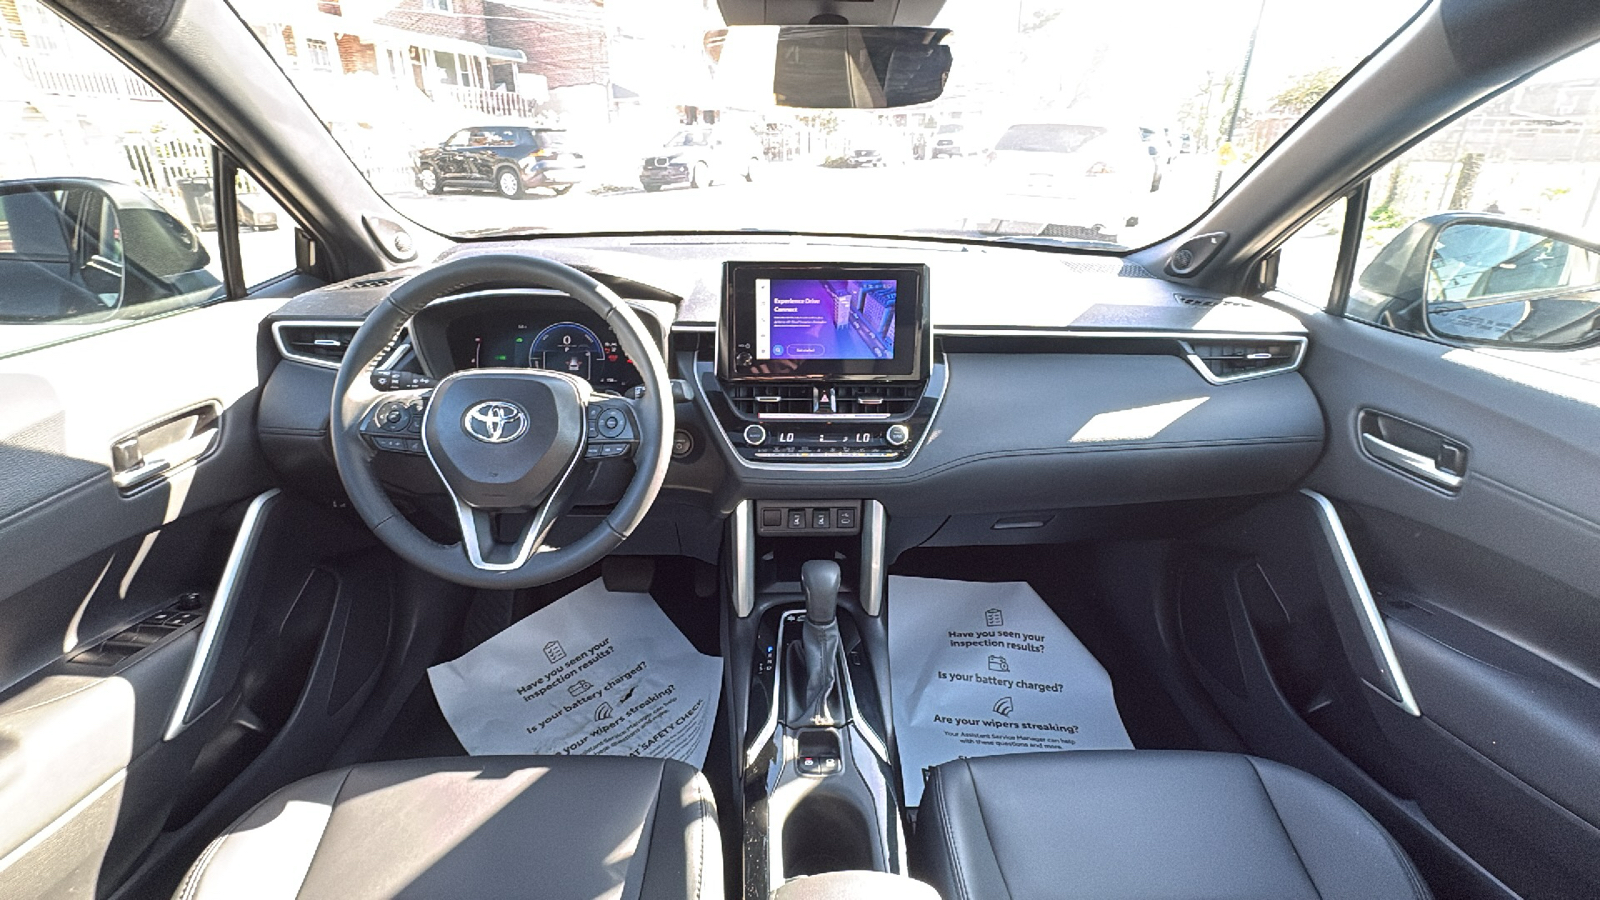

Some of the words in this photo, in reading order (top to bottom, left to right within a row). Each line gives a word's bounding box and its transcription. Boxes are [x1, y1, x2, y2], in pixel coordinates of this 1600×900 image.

[773, 297, 804, 305] Experience
[780, 432, 794, 443] LO
[856, 432, 871, 443] LO
[976, 630, 996, 639] you
[998, 630, 1021, 639] seen
[1022, 633, 1046, 643] your
[950, 639, 1005, 649] inspection
[1006, 642, 1046, 654] results?
[516, 677, 544, 696] Have
[544, 666, 564, 682] you
[565, 651, 589, 669] seen
[588, 637, 610, 656] your
[523, 668, 578, 703] inspection
[578, 646, 615, 672] results?
[938, 671, 948, 679] Is
[949, 673, 974, 682] your
[975, 673, 1014, 689] battery
[1015, 680, 1064, 693] charged?
[526, 726, 538, 735] Is
[538, 710, 563, 729] your
[563, 689, 603, 713] battery
[603, 661, 648, 692] charged?
[563, 737, 589, 756] your
[589, 716, 626, 737] wipers
[626, 684, 676, 718] streaking?
[933, 714, 953, 724] Are
[955, 716, 980, 726] your
[982, 719, 1020, 729] wipers
[1021, 722, 1079, 734] streaking?
[641, 723, 674, 750] SAFETY
[996, 740, 1028, 748] questions
[1017, 735, 1045, 743] Manager
[1060, 737, 1076, 745] help
